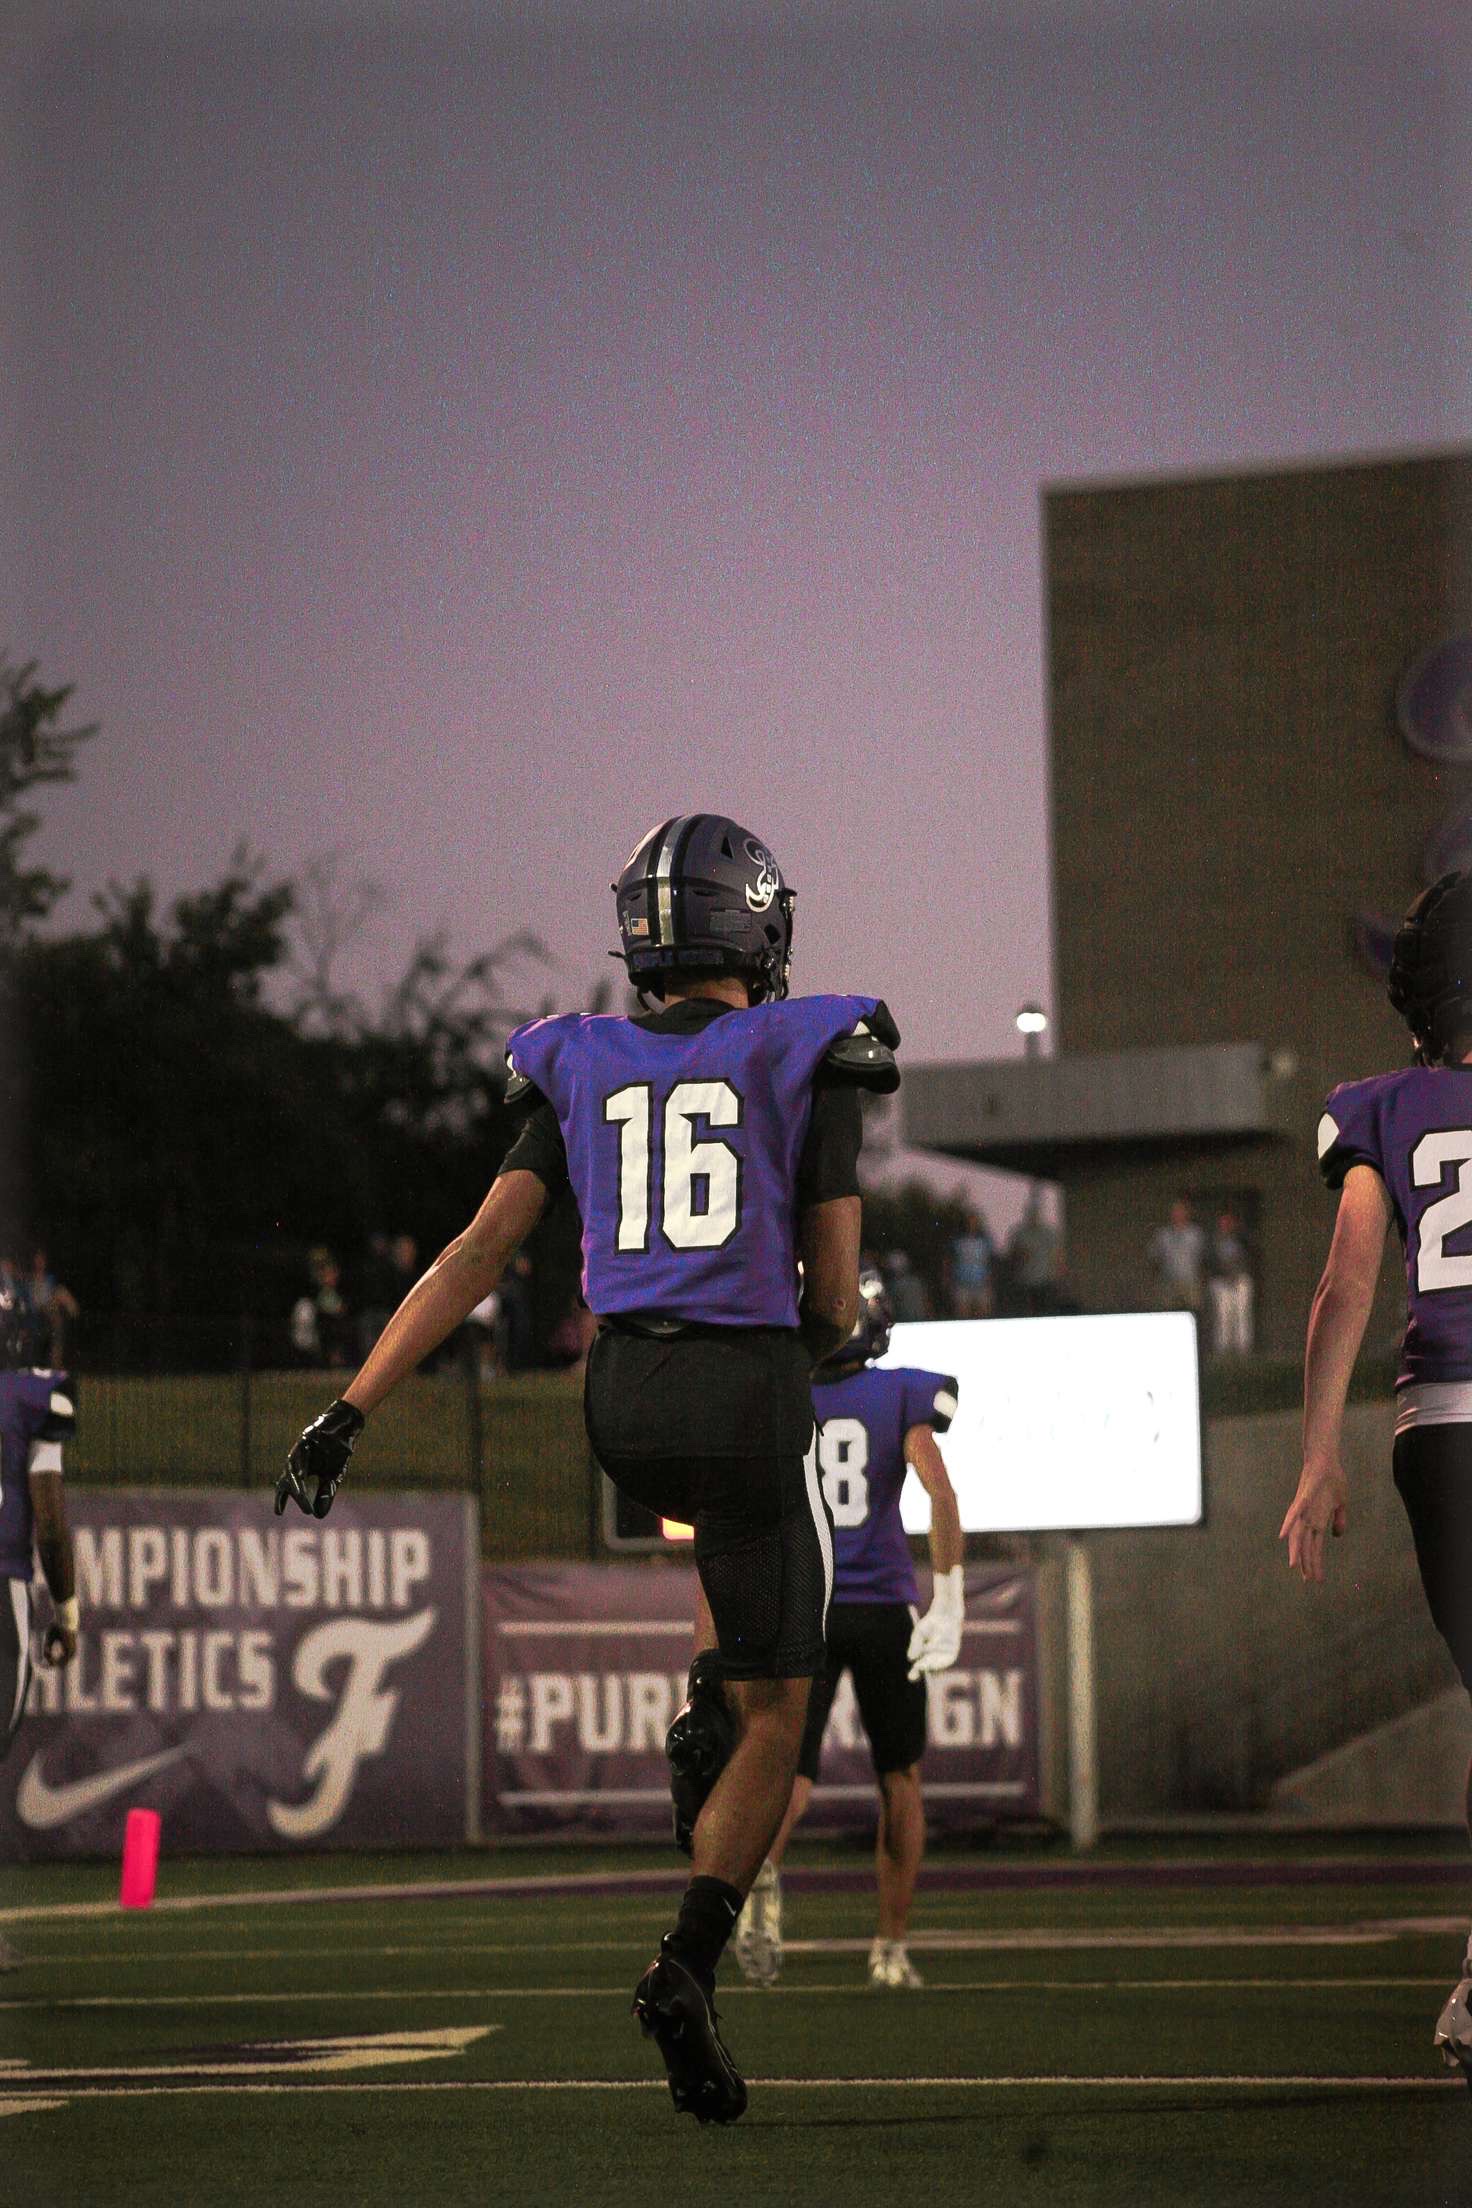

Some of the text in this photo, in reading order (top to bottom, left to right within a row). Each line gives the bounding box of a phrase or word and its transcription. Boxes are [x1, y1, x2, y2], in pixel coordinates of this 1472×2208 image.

[604, 1079, 741, 1252] 16
[1411, 1130, 1472, 1293] 2
[819, 1417, 869, 1527] 8
[33, 1527, 431, 1608] MPIONSHIP
[26, 1628, 273, 1712] HLETICS
[494, 1672, 691, 1753] #PUR
